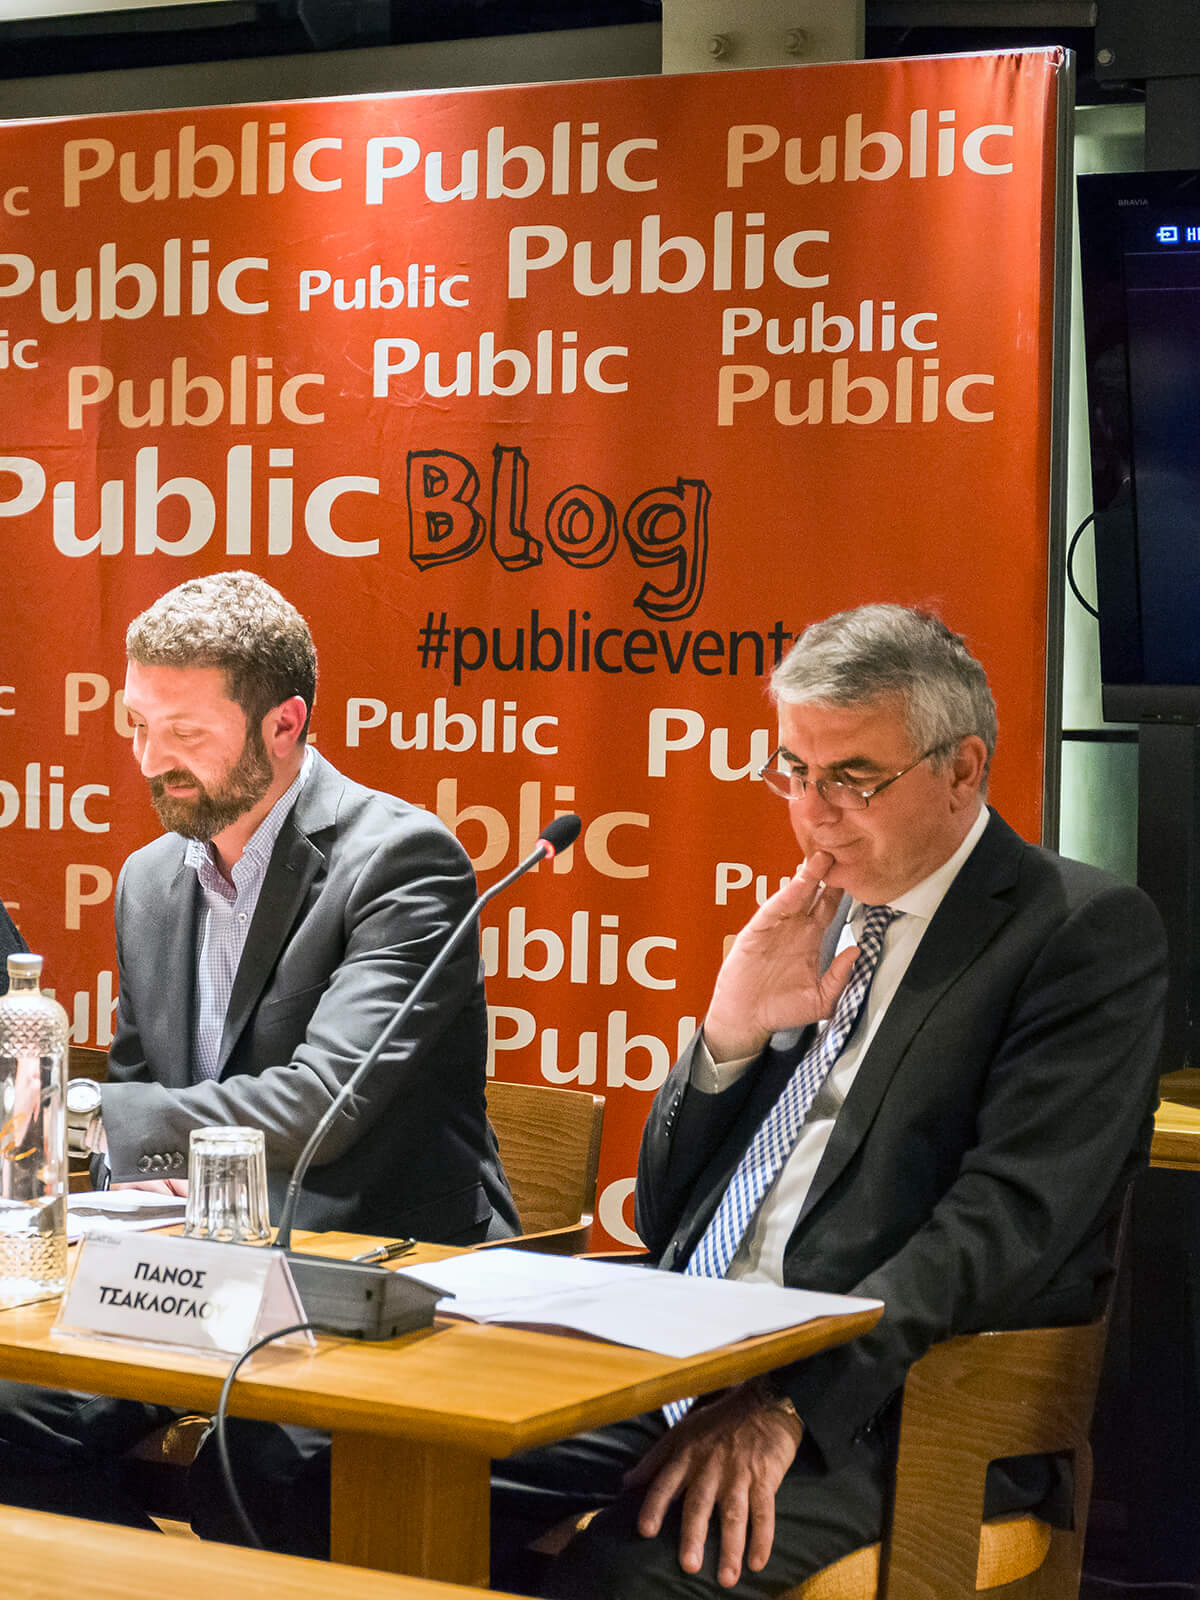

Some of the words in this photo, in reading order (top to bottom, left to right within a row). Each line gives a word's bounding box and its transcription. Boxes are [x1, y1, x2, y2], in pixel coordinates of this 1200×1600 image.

[63, 121, 343, 208] Public
[364, 121, 658, 206] Public
[725, 109, 1015, 188] Public
[298, 263, 470, 312] Public
[507, 210, 830, 299] Public
[373, 329, 629, 399] Public
[720, 299, 939, 356] Public
[67, 354, 326, 430] Public
[717, 356, 995, 426] Public
[406, 442, 712, 622] Blog
[416, 609, 800, 687] #publicevent
[345, 697, 559, 756] Public
[420, 778, 651, 879] blic
[134, 1262, 208, 1290] ΠΑΝΟΣ
